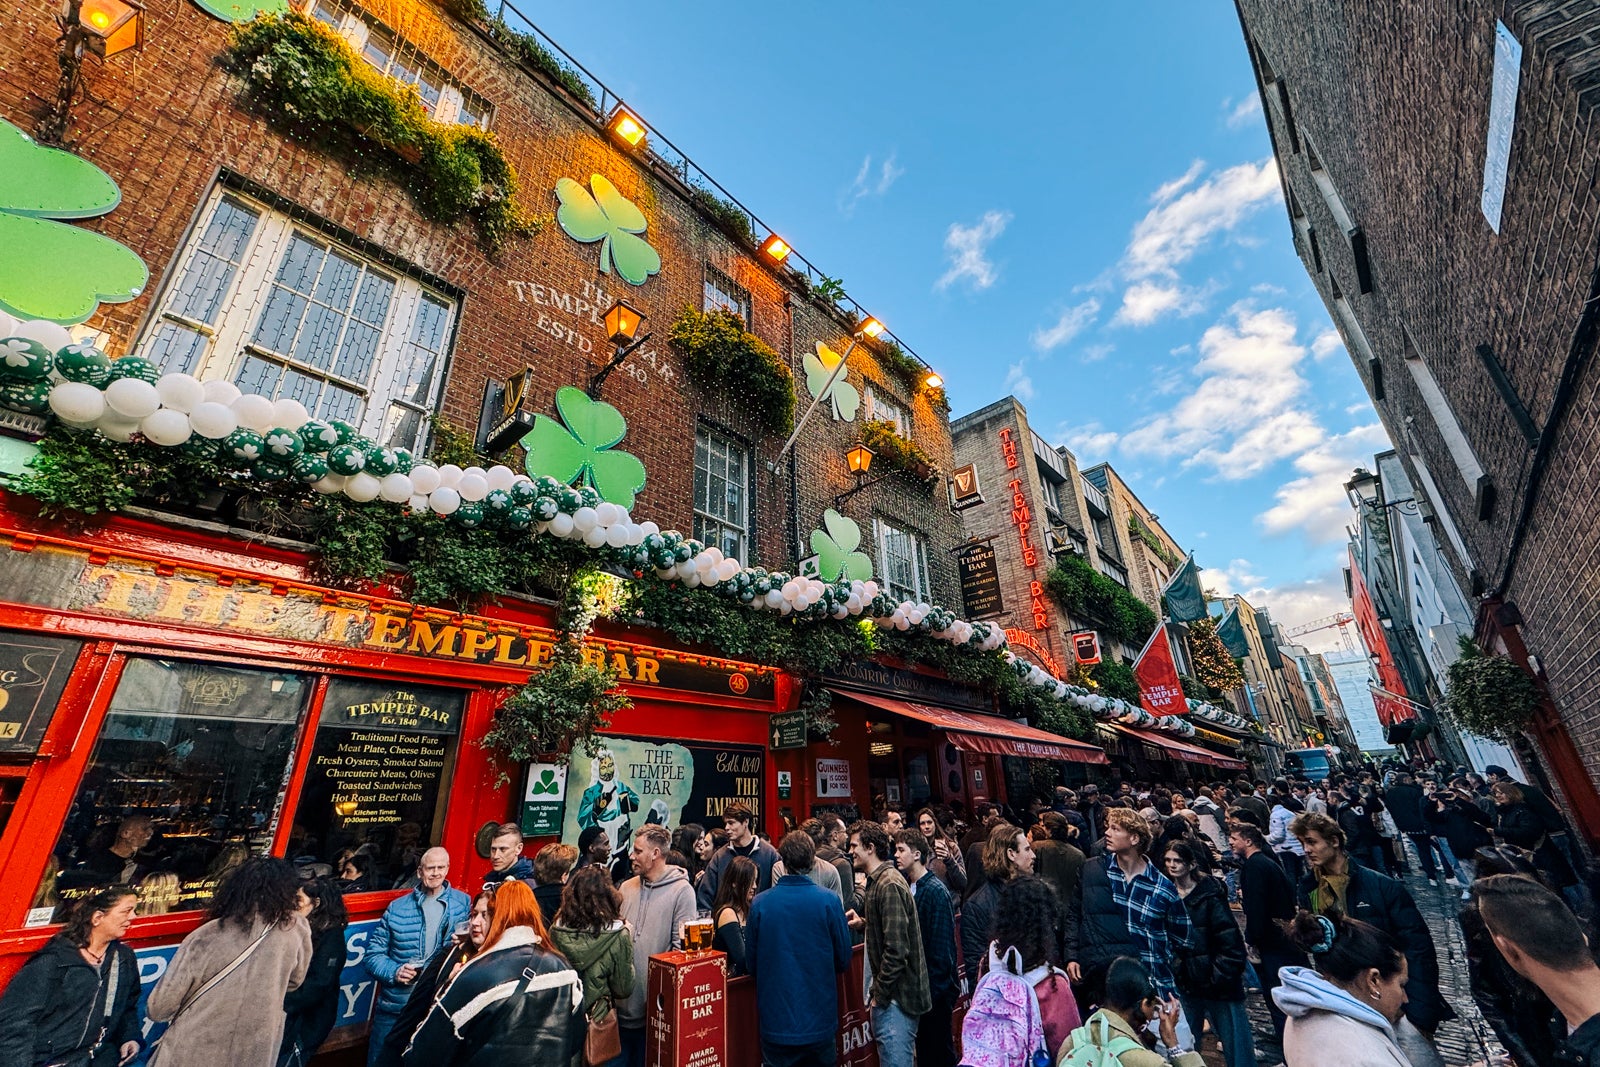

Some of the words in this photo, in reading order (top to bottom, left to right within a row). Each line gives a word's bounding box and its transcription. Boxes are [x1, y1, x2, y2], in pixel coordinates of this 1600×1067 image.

[581, 279, 612, 310] TH
[507, 279, 606, 328] TEMPL
[999, 428, 1019, 469] THE
[1008, 479, 1037, 568] TEMPLE
[960, 550, 994, 565] TEMPLE
[968, 561, 987, 571] BAR
[980, 595, 998, 603] MUSIC
[1030, 580, 1049, 630] BAR
[84, 565, 288, 633] THE
[318, 602, 556, 668] TEMPLE
[733, 676, 745, 691] 48
[396, 691, 415, 701] The
[1151, 698, 1172, 707] BAR
[347, 702, 417, 717] TEMPLE
[419, 706, 450, 724] BAR
[381, 716, 397, 725] Est.
[399, 717, 418, 726] 1840
[351, 732, 397, 743] Traditional
[399, 735, 420, 744] Food
[421, 737, 439, 745] Fare
[338, 744, 361, 753] Meat
[363, 744, 387, 754] Plate,
[389, 745, 419, 755] Cheese
[420, 747, 444, 756] Board
[1012, 741, 1026, 752] THE
[1026, 743, 1050, 755] TEMPLE
[1050, 747, 1061, 756] BAR
[316, 756, 343, 765] Fresh
[345, 757, 381, 768] Oysters,
[382, 758, 417, 767] Smoked
[645, 749, 673, 765] THE
[628, 764, 685, 780] TEMPLE
[741, 757, 760, 774] 1840
[817, 761, 848, 773] GUINNESS
[326, 768, 378, 778] Charcuterie
[379, 769, 408, 779] Meats,
[410, 770, 436, 779] Olives
[336, 781, 372, 790] Toasted
[372, 781, 423, 790] Sandwiches
[643, 779, 672, 796] BAR
[735, 777, 759, 796] THE
[330, 793, 350, 803] Hot
[351, 793, 377, 802] Roast
[378, 793, 400, 802] Beef
[400, 793, 423, 802] Rolls
[694, 983, 710, 994] THE
[682, 990, 722, 1010] TEMPLE
[692, 1005, 713, 1020] BAR
[842, 1020, 873, 1055] BAR
[685, 1054, 718, 1067] WINNING
[689, 1046, 715, 1061] AWARD
